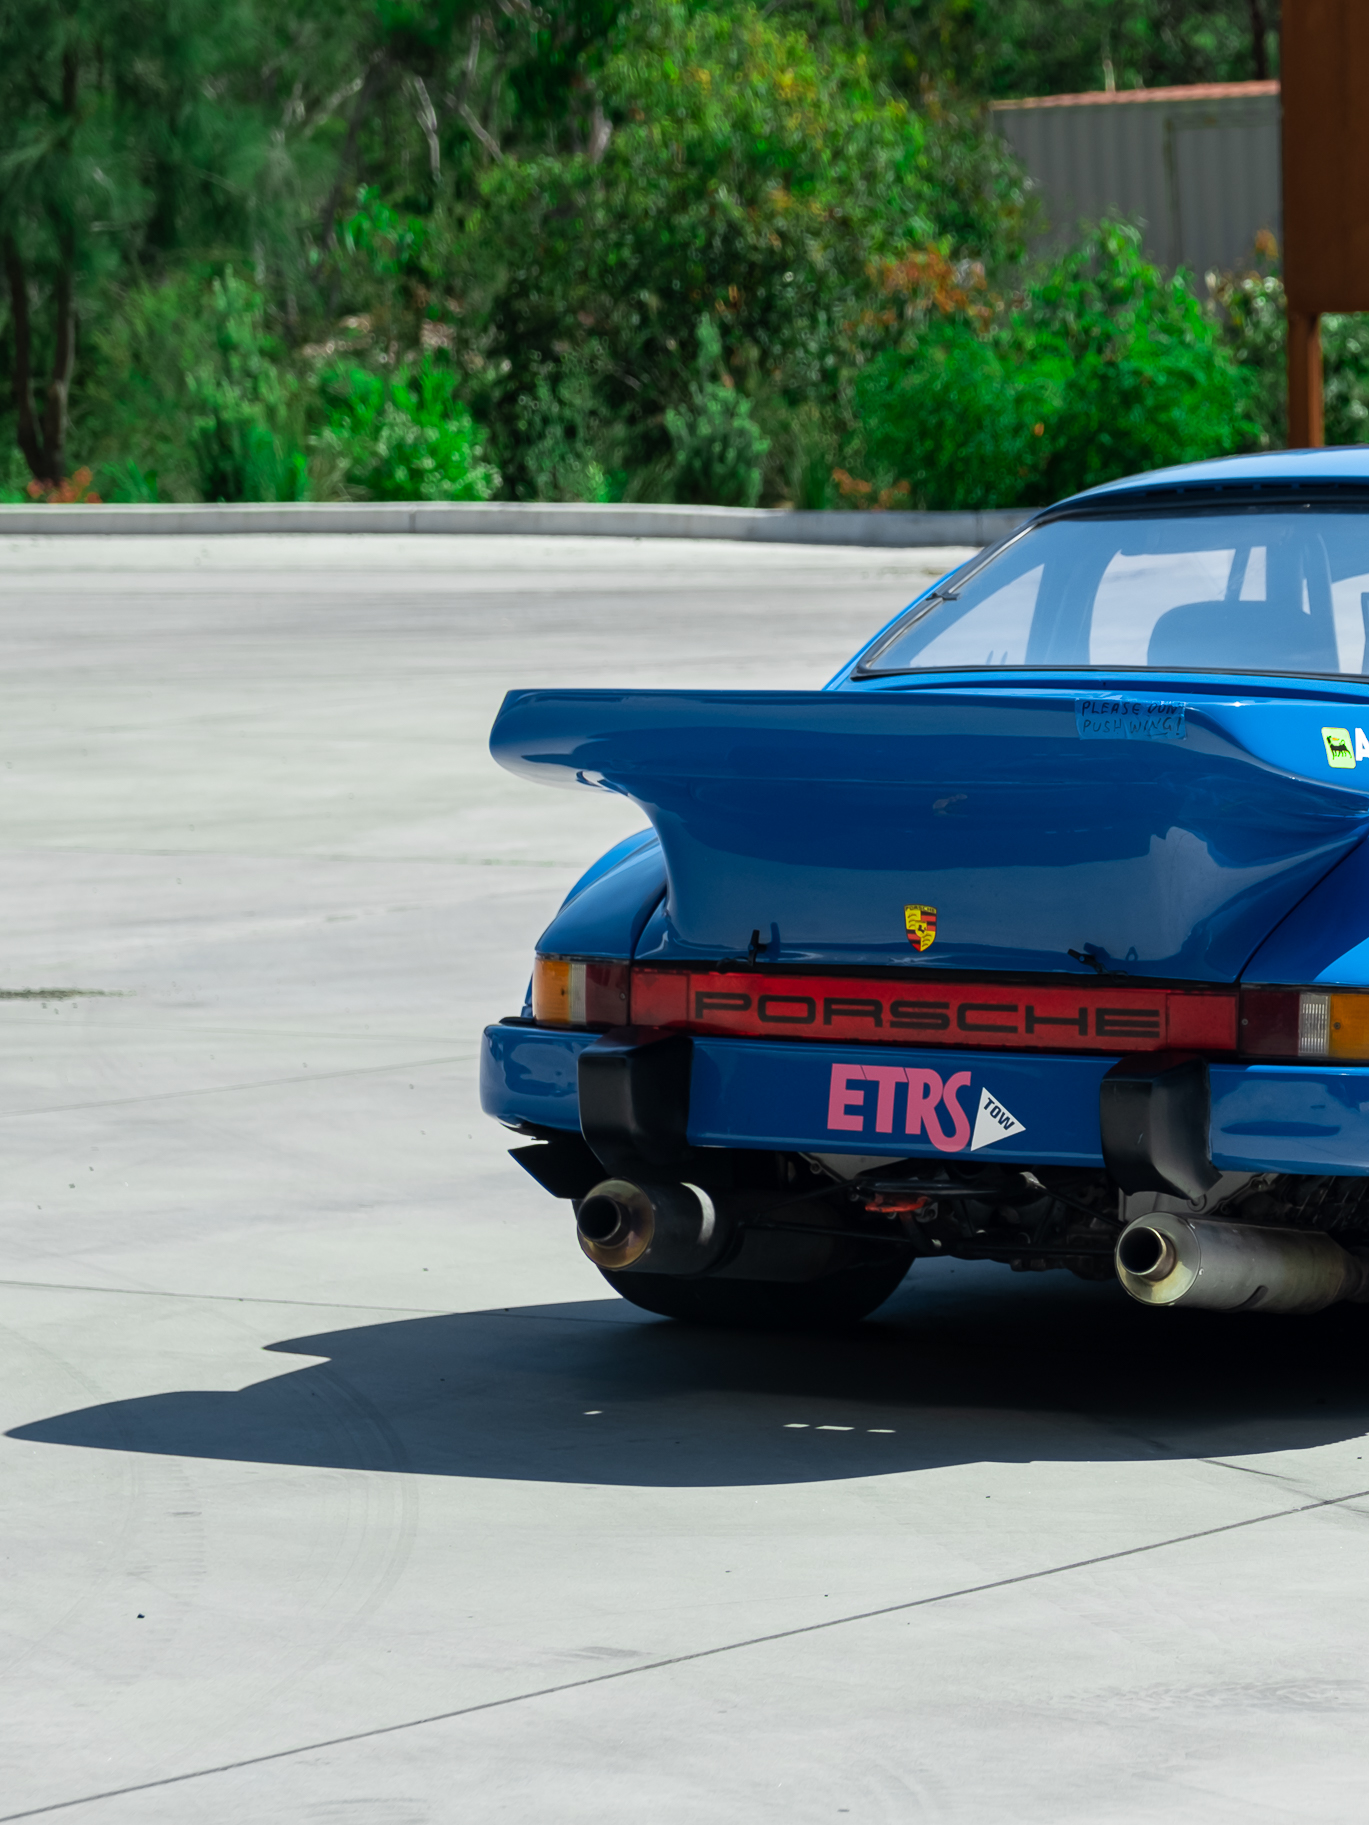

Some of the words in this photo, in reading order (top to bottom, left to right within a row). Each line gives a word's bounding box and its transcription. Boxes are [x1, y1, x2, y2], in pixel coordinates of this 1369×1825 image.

[1082, 701, 1141, 716] PLEASE
[1083, 718, 1122, 735] PUSH
[694, 990, 1161, 1039] PORSCHE
[827, 1062, 972, 1153] ETRS
[983, 1097, 1016, 1131] TOW
